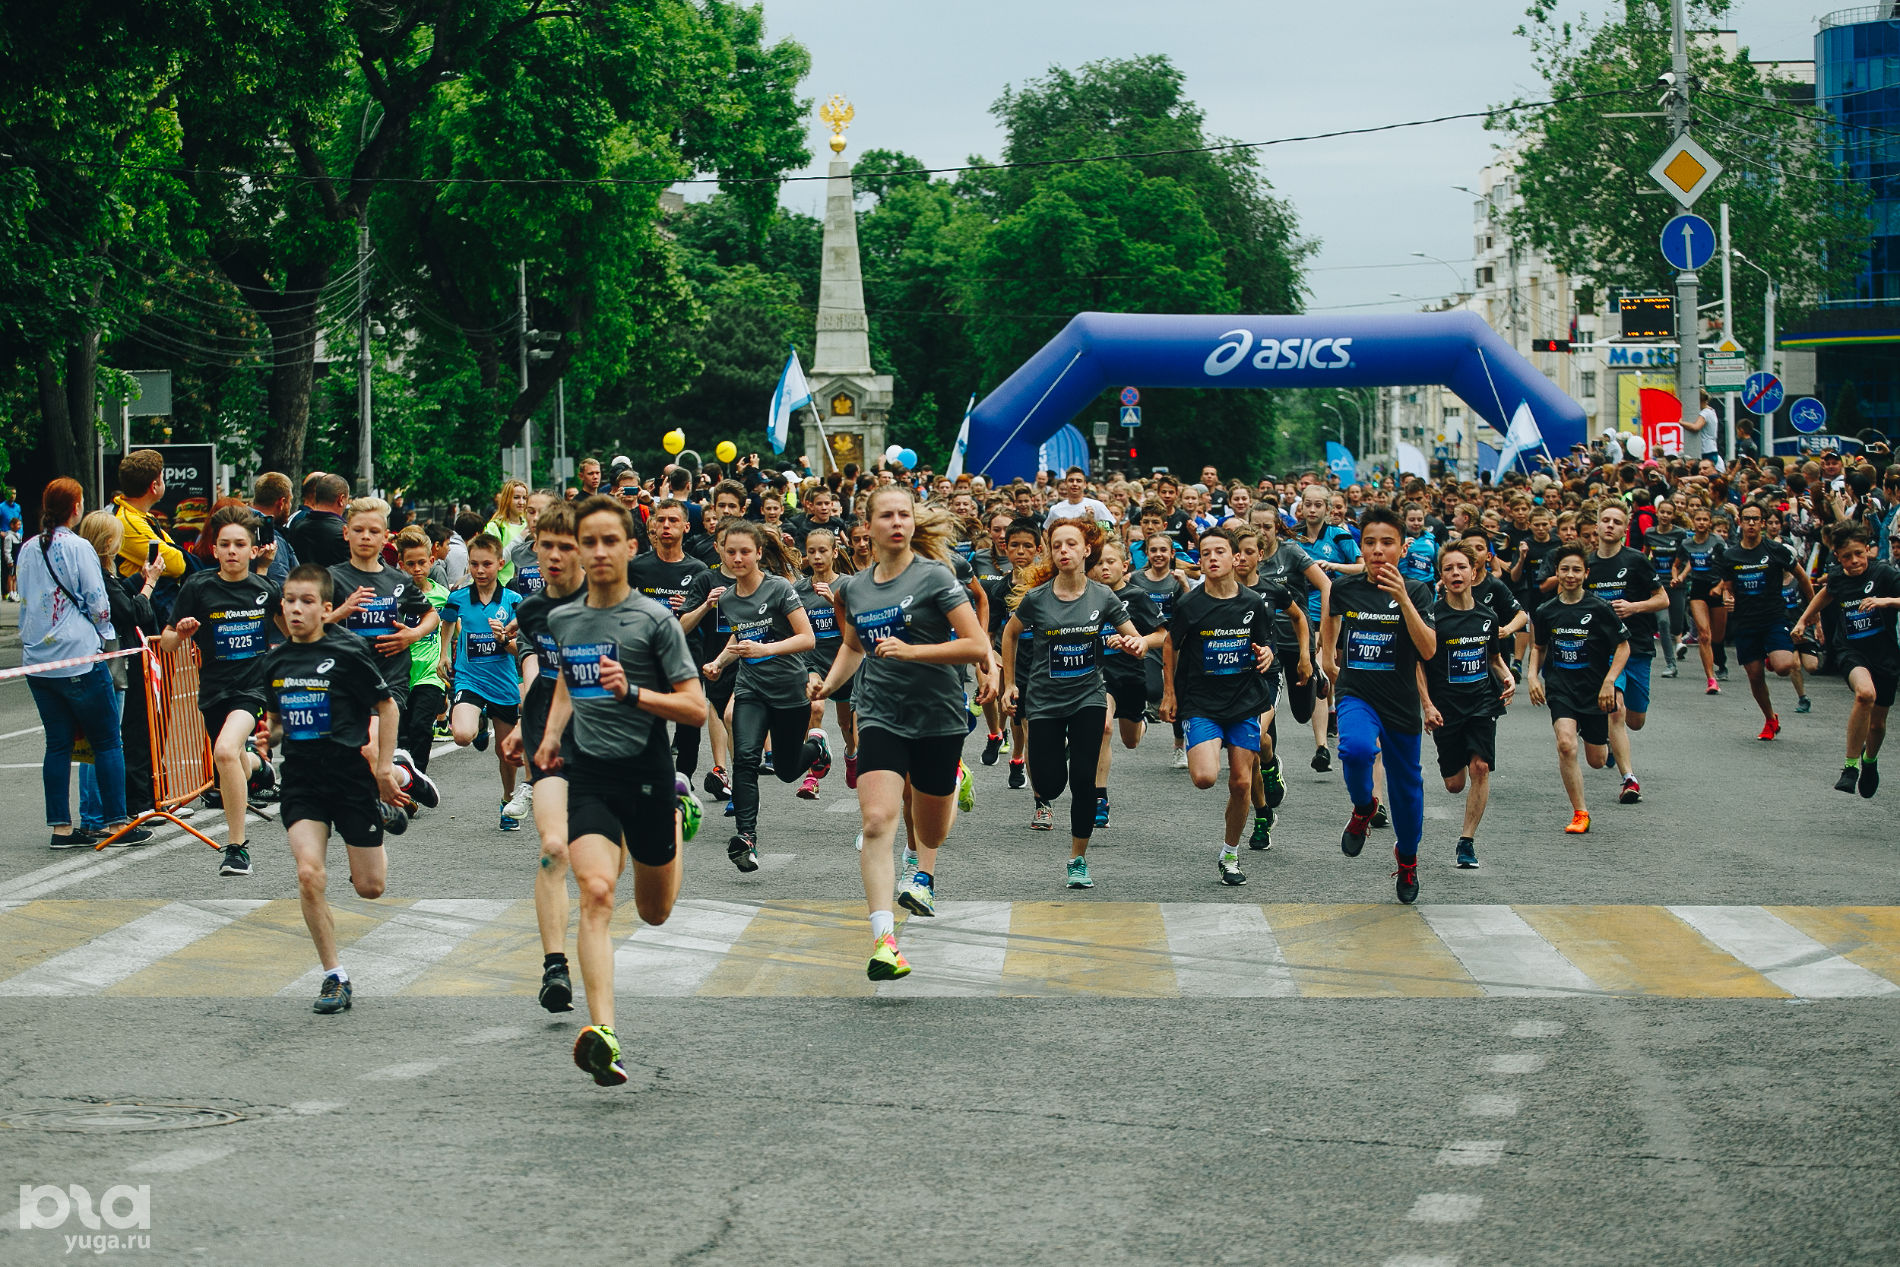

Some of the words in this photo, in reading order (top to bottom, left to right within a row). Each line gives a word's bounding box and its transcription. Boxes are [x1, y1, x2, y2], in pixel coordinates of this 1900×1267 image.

[361, 611, 386, 624] 9124
[857, 607, 899, 624] #RunAsics2017
[217, 621, 261, 632] #RunAsics2017
[815, 617, 833, 629] 9069
[228, 635, 253, 649] 9225
[1352, 631, 1393, 642] #RunAsics2017
[476, 641, 496, 653] 7049
[1053, 641, 1093, 652] #RunAsics2017
[1208, 638, 1248, 649] #RunAsics2017
[1358, 644, 1381, 658] 7079
[1560, 650, 1578, 661] 7038
[1063, 655, 1084, 667] 9111
[1217, 652, 1239, 665] 9254
[1461, 660, 1480, 671] 7103
[572, 663, 600, 681] 9019
[288, 710, 314, 726] 9216
